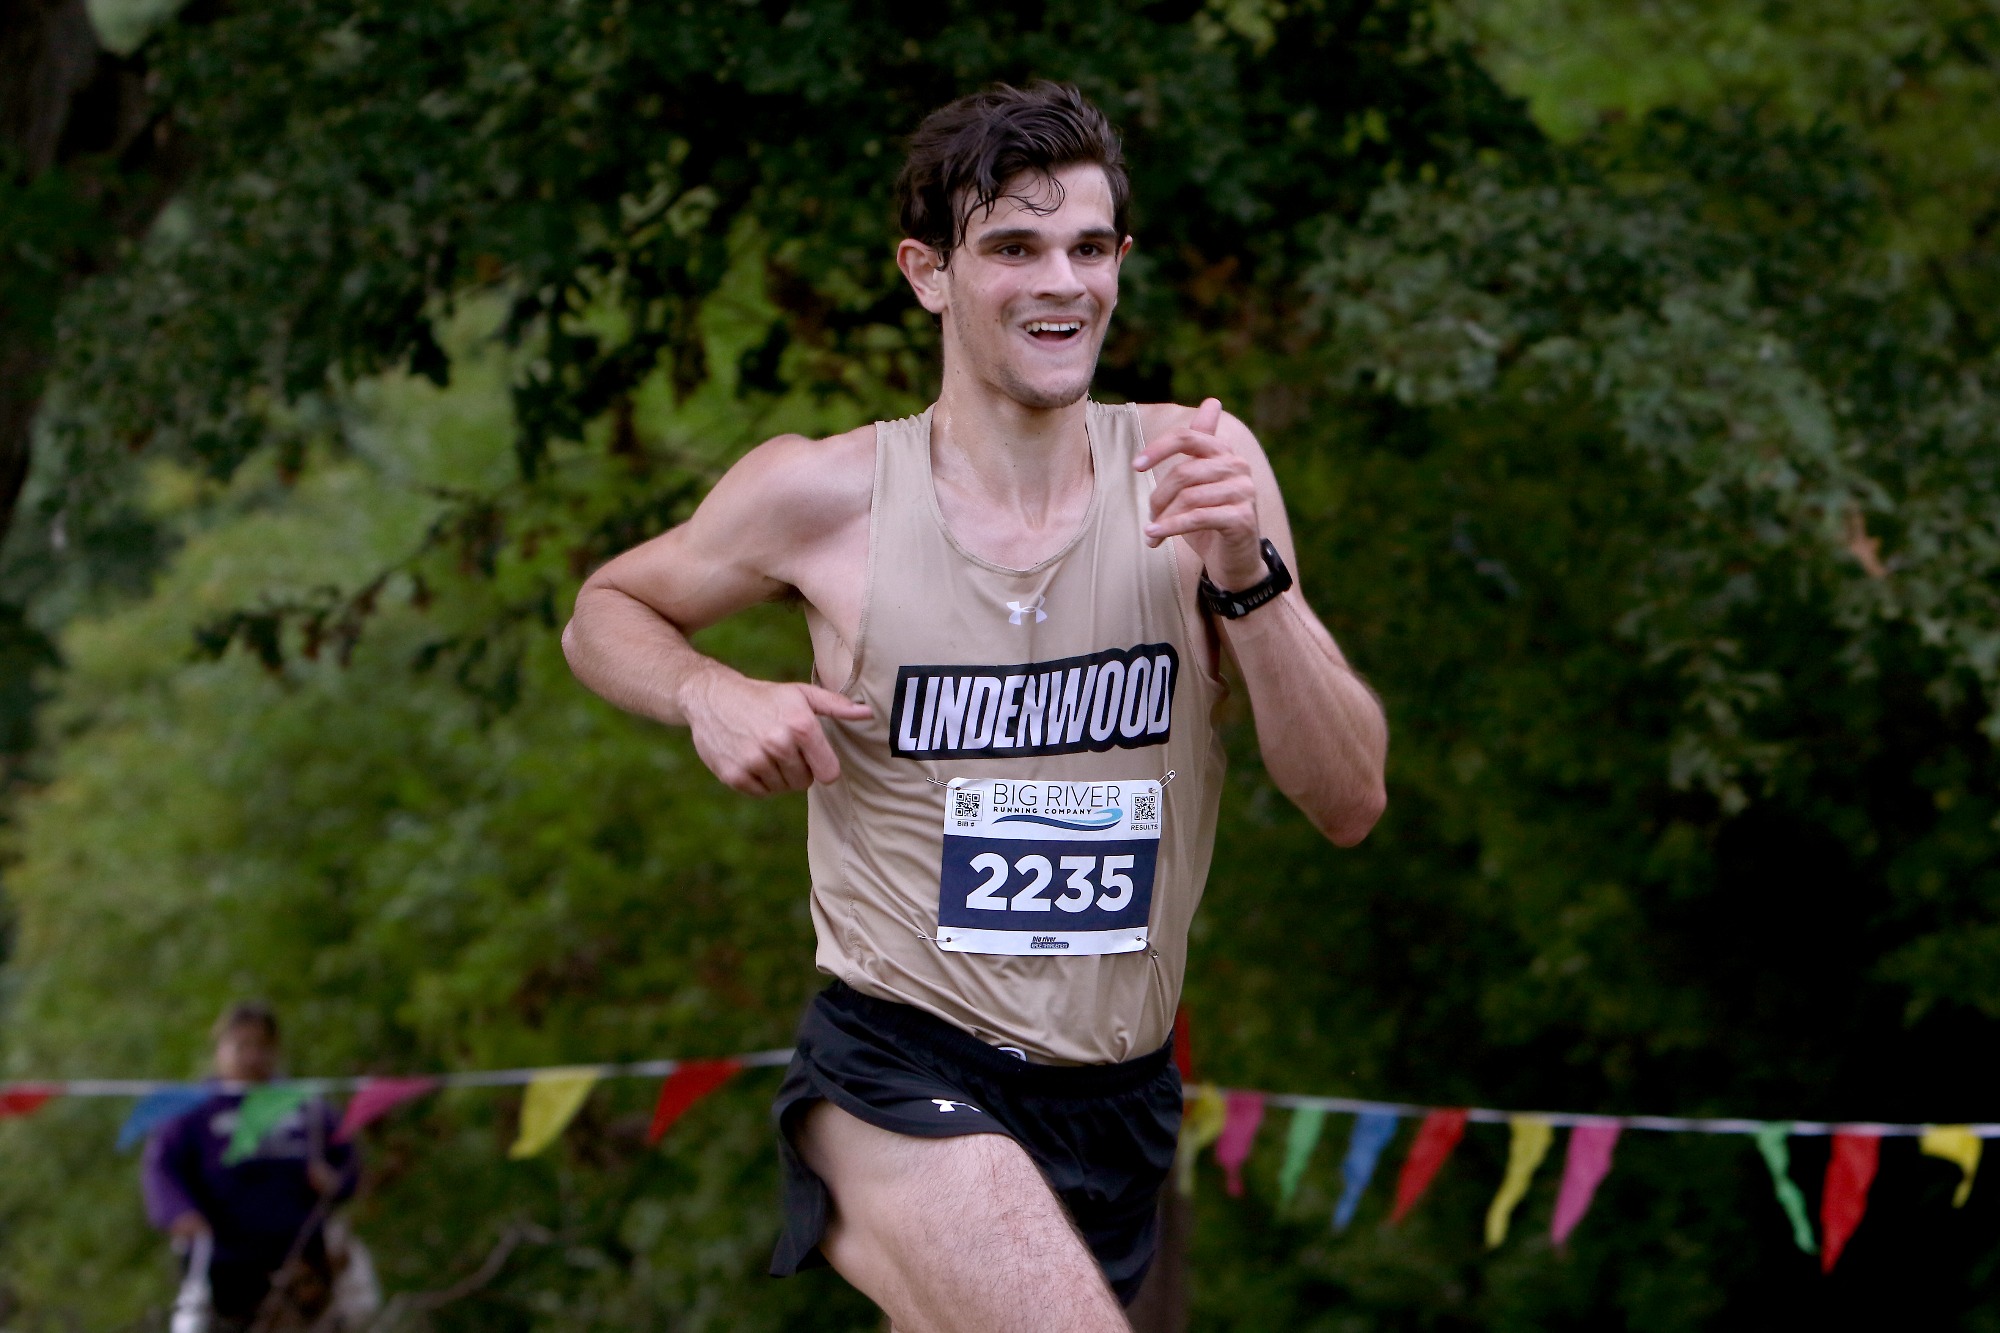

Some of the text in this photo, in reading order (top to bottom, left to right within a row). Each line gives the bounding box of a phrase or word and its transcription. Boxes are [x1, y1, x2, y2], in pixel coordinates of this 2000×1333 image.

[898, 654, 1171, 751] LINDENWOOD
[993, 783, 1121, 807] BIG RIVER
[993, 806, 1038, 814] RUNNING
[965, 852, 1135, 913] 2235
